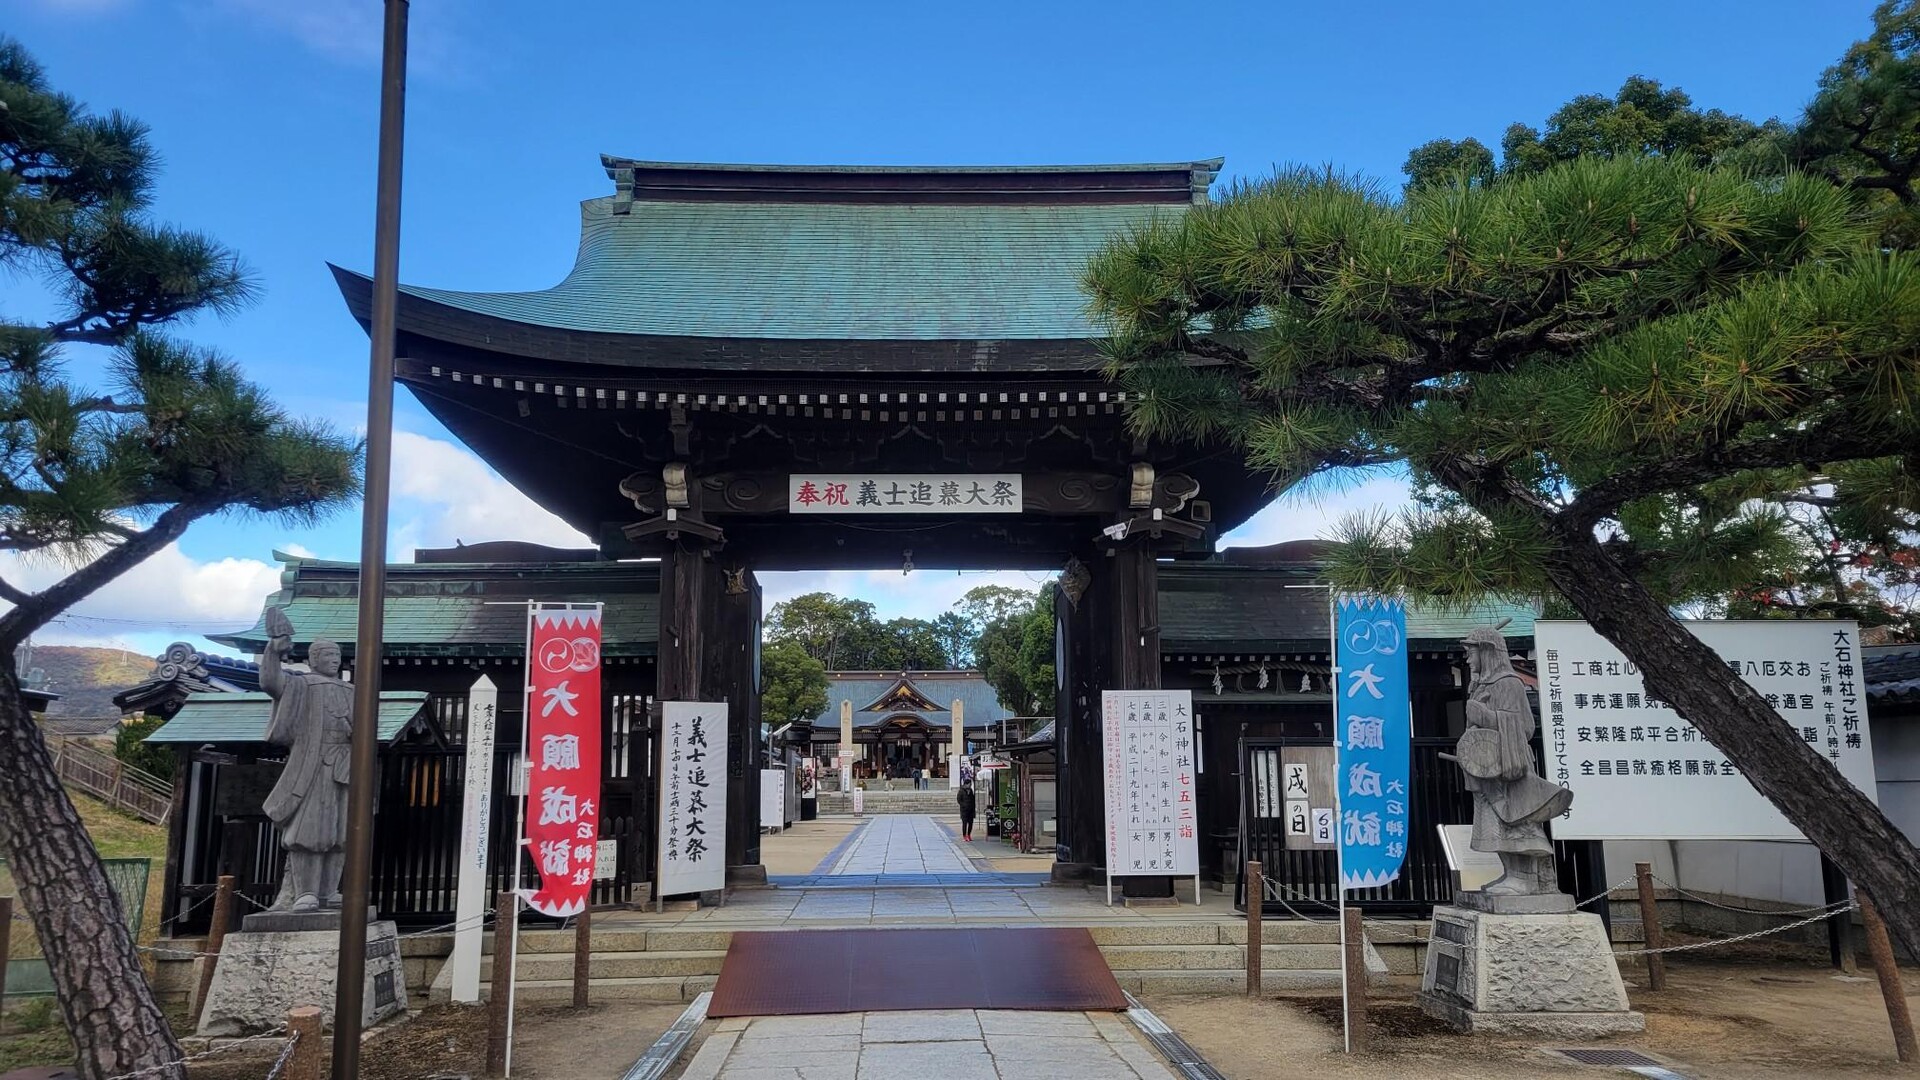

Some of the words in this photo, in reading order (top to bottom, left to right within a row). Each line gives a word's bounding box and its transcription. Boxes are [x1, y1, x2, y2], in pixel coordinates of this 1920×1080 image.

[1127, 701, 1138, 722] 七歳
[1143, 701, 1153, 722] 五歳
[1158, 700, 1168, 723] 三歳
[1797, 661, 1818, 743] お宮詣
[1833, 630, 1862, 749] 大石神社ご祈祷
[1546, 649, 1573, 820] 毎日ご祈願受付けておりす
[1645, 693, 1665, 776] 気平癒
[685, 716, 710, 863] 義士追慕大祭
[1128, 732, 1141, 824] 平成二十九年生れ
